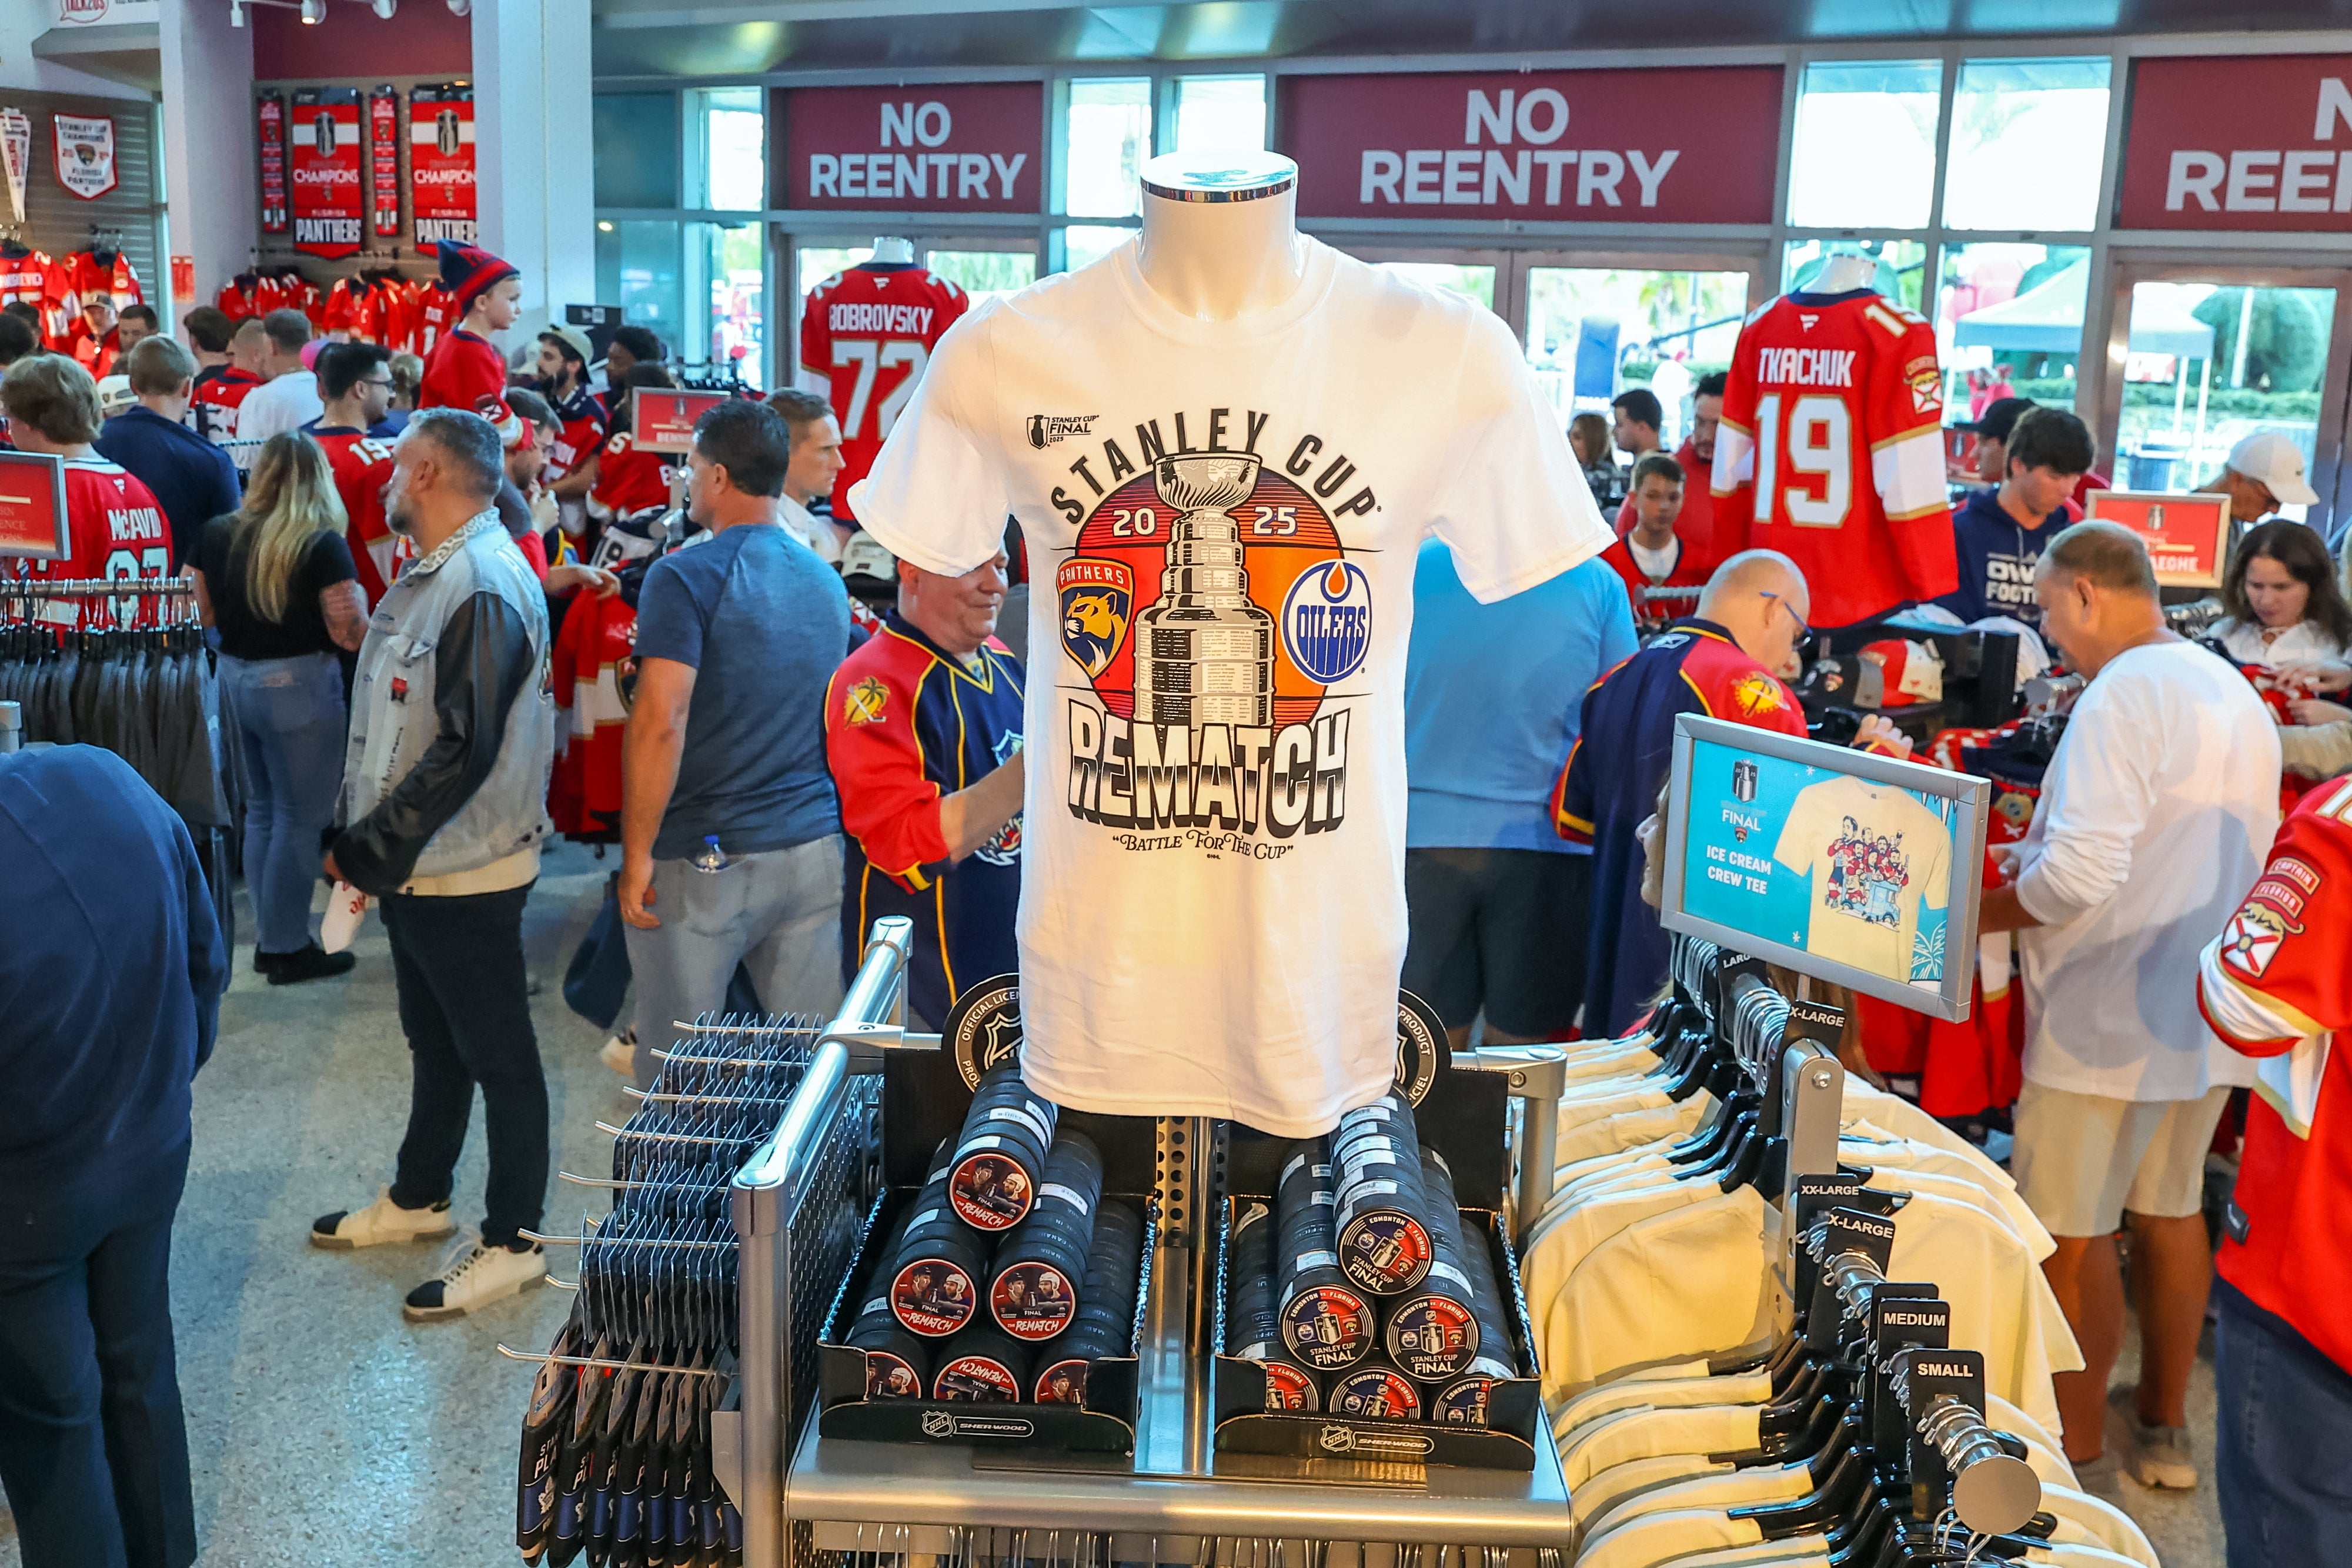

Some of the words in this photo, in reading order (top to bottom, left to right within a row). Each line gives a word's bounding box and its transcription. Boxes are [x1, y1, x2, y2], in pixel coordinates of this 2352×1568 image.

[880, 102, 951, 148] NO
[1465, 88, 1569, 145] NO
[293, 169, 360, 183] CHAMPIONS
[810, 153, 1028, 199] REENTRY
[1359, 149, 1679, 208] REENTRY
[295, 218, 361, 243] PANTHERS
[828, 303, 934, 335] BOBROVSKY
[1758, 347, 1857, 388] TKACHUK
[831, 339, 930, 442] 72
[1050, 423, 1091, 434] FINAL
[349, 437, 392, 467] 19
[1754, 392, 1852, 529] 19
[1051, 408, 1269, 524] STANLEY
[1285, 434, 1376, 519] CUP
[1112, 508, 1157, 536] 20
[1254, 506, 1298, 537] 25
[1059, 564, 1124, 586] PANTHERS
[1297, 604, 1366, 678] OILERS
[1068, 698, 1351, 838] REMATCH
[1722, 808, 1762, 832] FINAL
[1706, 844, 1727, 862] ICE
[1729, 851, 1772, 875] CREAM
[2274, 860, 2313, 885] CAPTAIN
[1707, 865, 1743, 887] CREW
[1745, 876, 1768, 895] TEE
[2259, 884, 2297, 909] FLORIDA
[961, 1001, 994, 1041] OFFICIAL
[1789, 1006, 1846, 1028] X-LARGE
[1398, 1009, 1431, 1056] PRODUCT
[1409, 1075, 1429, 1101] ICIEL
[977, 1196, 994, 1208] FINAL
[1800, 1185, 1860, 1196] XX-LARGE
[961, 1202, 1005, 1228] REMATCH
[1828, 1213, 1894, 1239] X-LARGE
[1369, 1216, 1406, 1226] EDMONTON
[1412, 1229, 1426, 1255] FLORIDA
[1348, 1263, 1384, 1292] FINAL
[1352, 1255, 1381, 1276] STANLEY
[1379, 1273, 1394, 1284] CUP
[921, 1305, 939, 1313] FINAL
[1291, 1293, 1318, 1318] EDMONTON
[1329, 1292, 1356, 1307] FLORIDA
[1397, 1301, 1428, 1324] EDMONTON
[1439, 1302, 1465, 1320] FLORIDA
[908, 1312, 954, 1331] REMATCH
[1015, 1320, 1060, 1332] REMATCH
[1883, 1312, 1946, 1326] MEDIUM
[1309, 1344, 1341, 1356] STANLEY
[1315, 1350, 1356, 1366] FINAL
[1410, 1355, 1442, 1363] STANLEY
[958, 1361, 1004, 1383] REMATCH
[1414, 1361, 1455, 1374] FINAL
[1917, 1363, 1974, 1378] SMALL
[1349, 1374, 1385, 1386] EDMONTON
[1394, 1380, 1414, 1404] FLORIDA
[1446, 1382, 1480, 1400] EDMONTON
[929, 1418, 947, 1431] NHL
[1327, 1433, 1347, 1445] NHL
